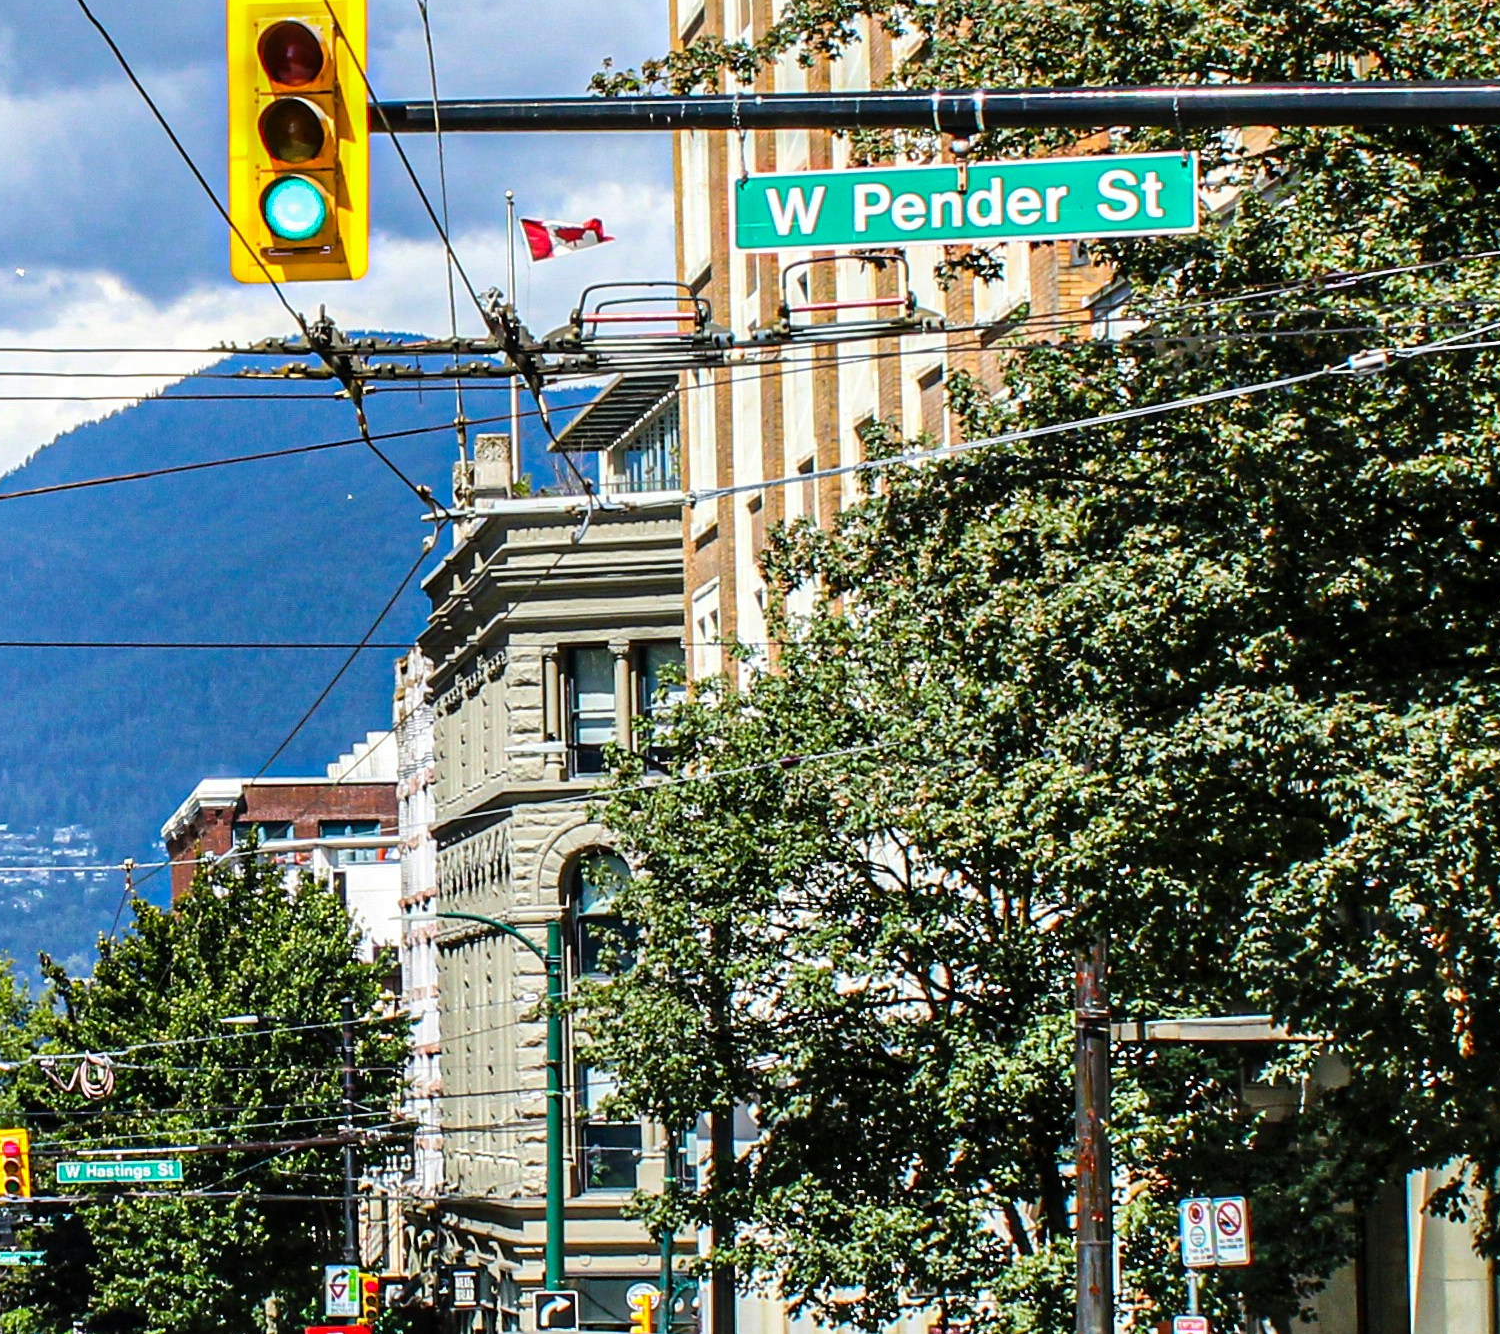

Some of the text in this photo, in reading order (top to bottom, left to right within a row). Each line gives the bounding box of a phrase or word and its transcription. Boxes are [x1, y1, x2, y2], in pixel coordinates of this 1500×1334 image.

[766, 169, 1164, 236] W Pender St
[64, 1163, 175, 1180] W Hastings St
